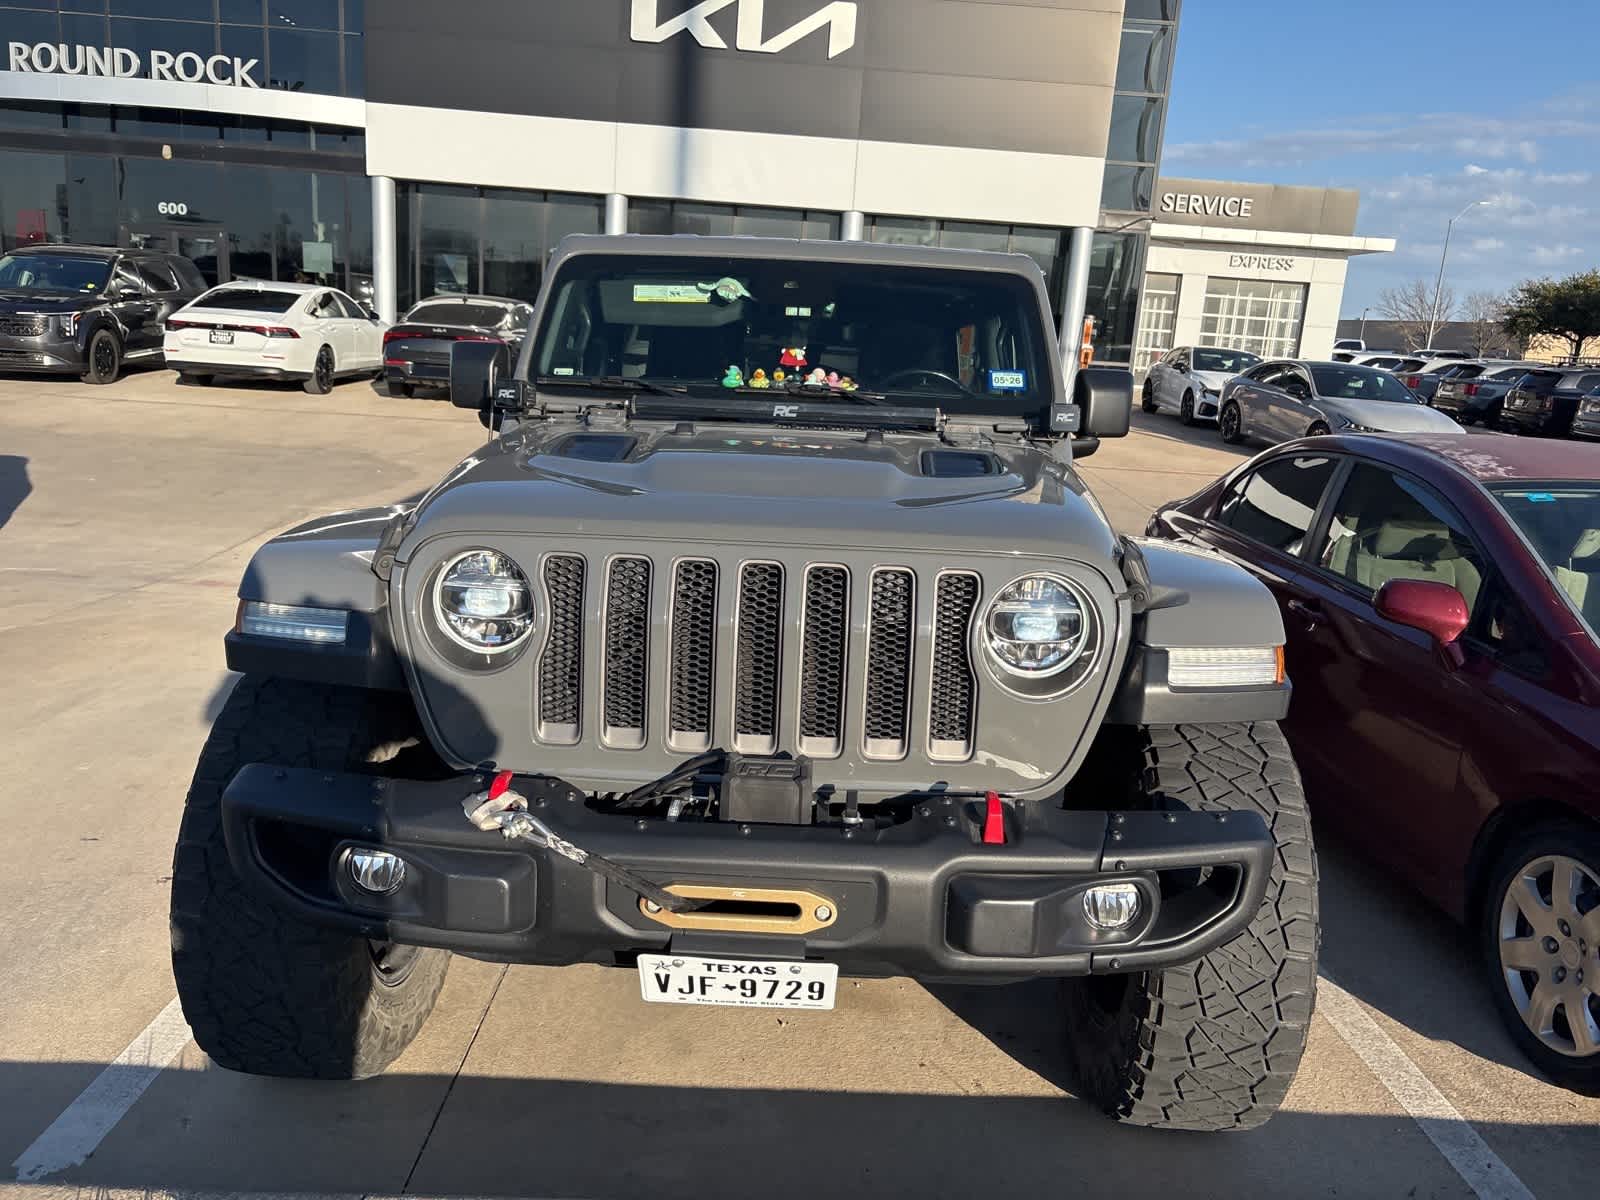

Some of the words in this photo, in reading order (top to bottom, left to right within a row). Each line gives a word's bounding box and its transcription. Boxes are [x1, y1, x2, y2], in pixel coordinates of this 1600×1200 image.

[9, 41, 140, 77] ROUND
[151, 50, 260, 88] ROCK
[157, 201, 188, 216] 600
[1160, 192, 1254, 218] SERVICE
[1229, 254, 1295, 271] EXPRESS
[498, 389, 515, 398] RC
[773, 405, 799, 417] RC
[1056, 412, 1074, 422] RC
[702, 962, 777, 976] TEXAS
